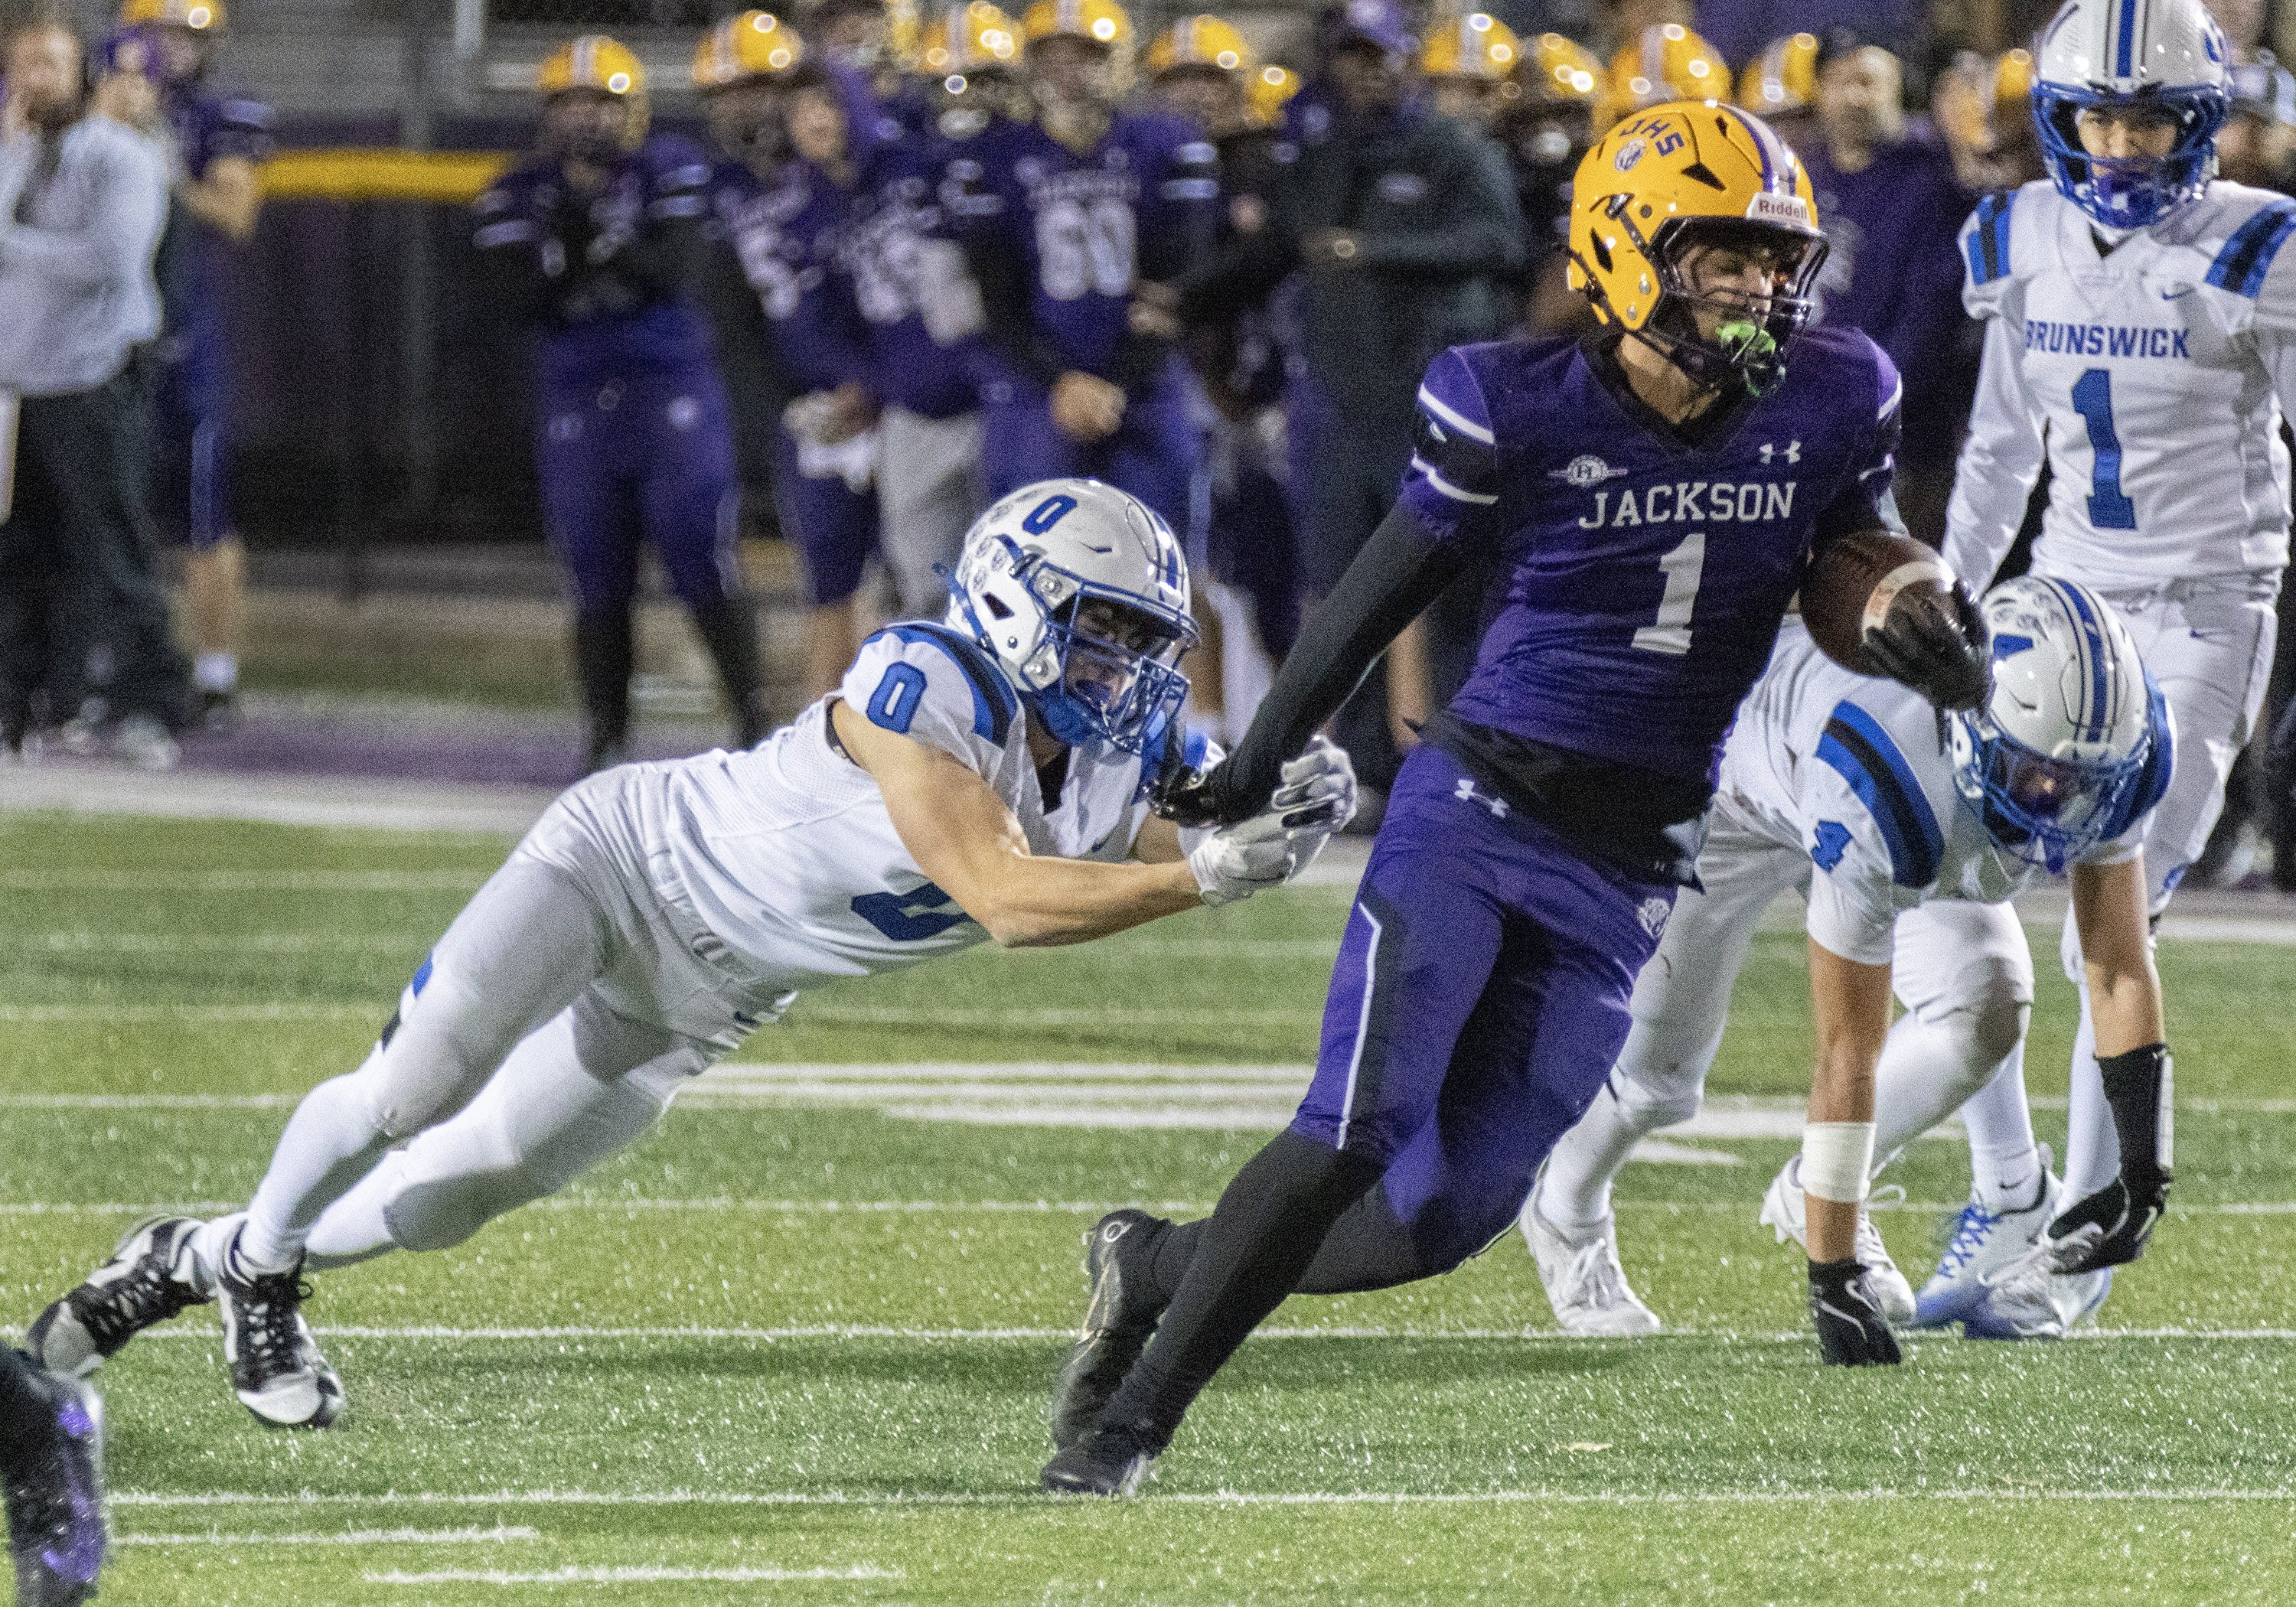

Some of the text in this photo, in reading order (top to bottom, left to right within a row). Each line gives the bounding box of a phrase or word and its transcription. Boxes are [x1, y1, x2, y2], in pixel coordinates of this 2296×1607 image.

[1618, 119, 1684, 157] JHS
[1760, 200, 1808, 220] Riddell
[2027, 319, 2191, 360] BRUNSWICK
[2073, 368, 2136, 530] 1
[1022, 494, 1078, 536] 0
[1578, 481, 1797, 530] JACKSON
[1631, 533, 1706, 655] 1
[866, 670, 928, 734] 0
